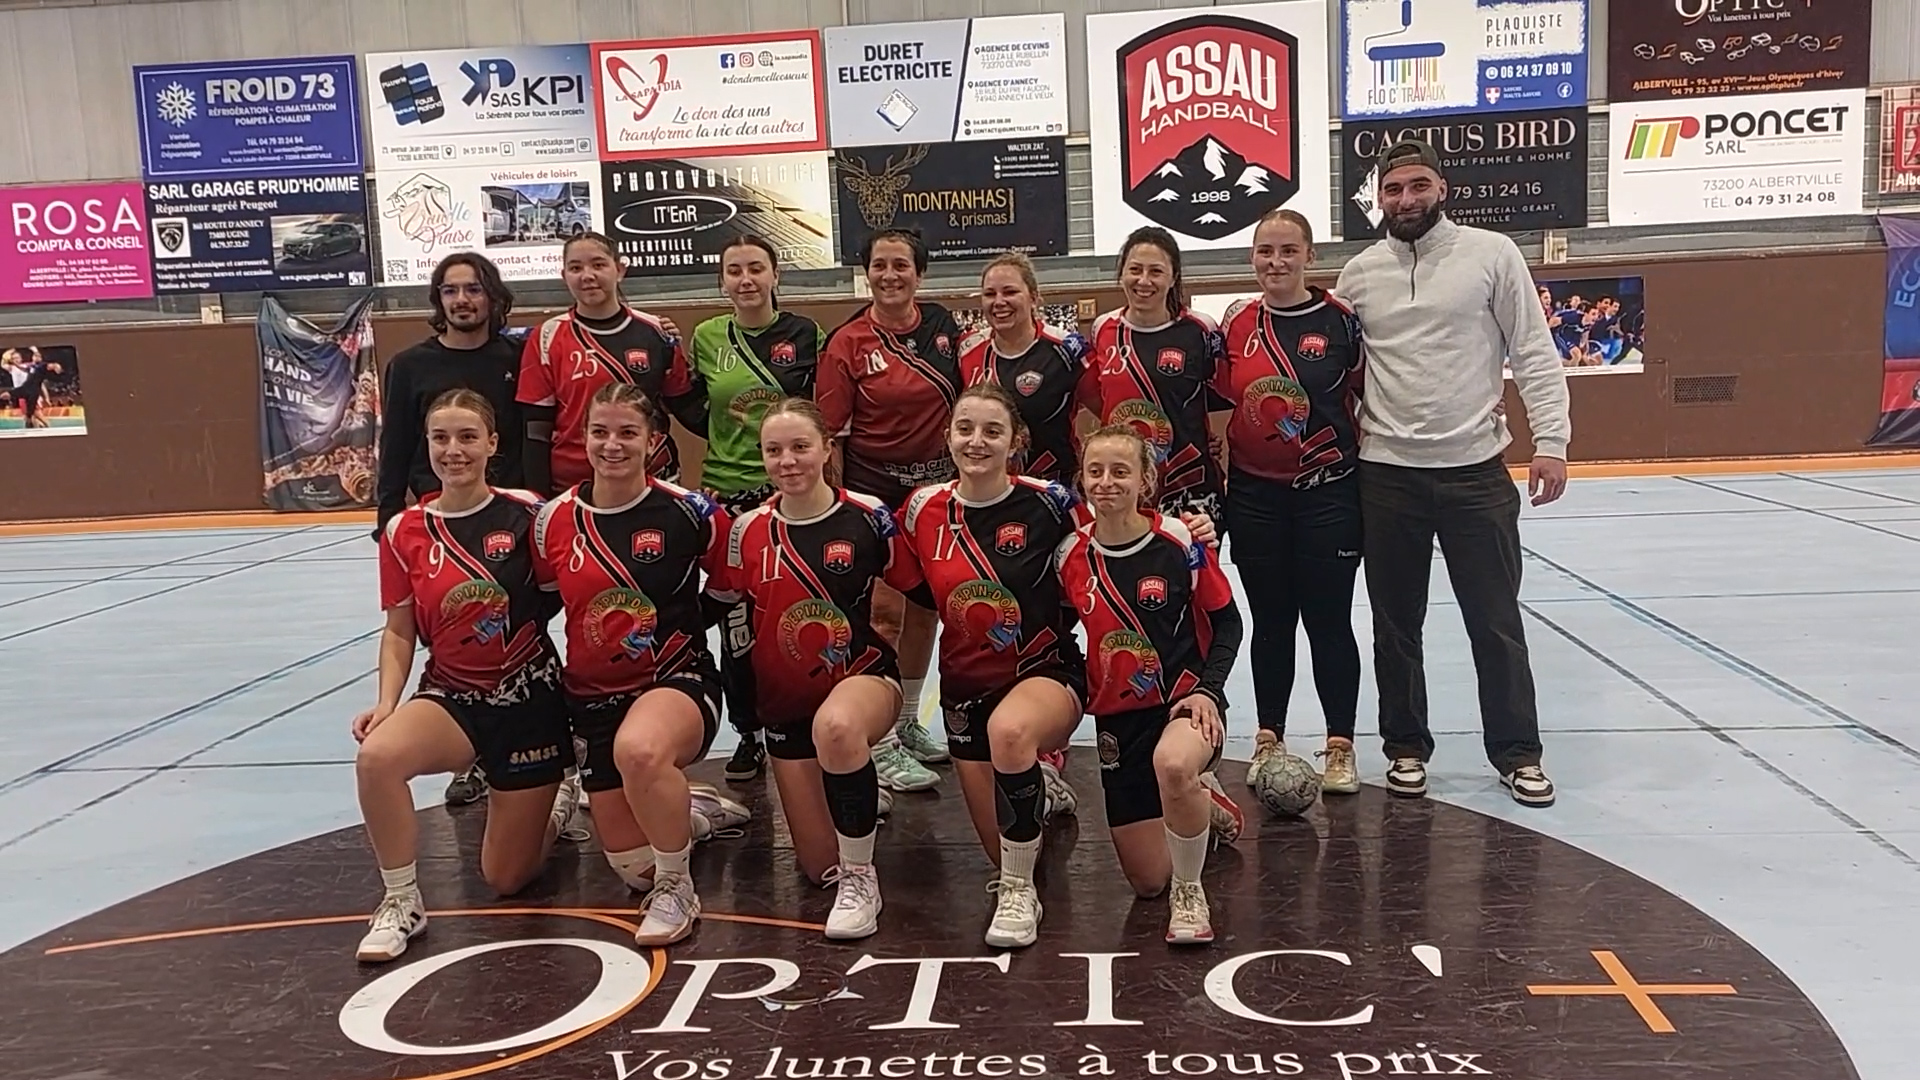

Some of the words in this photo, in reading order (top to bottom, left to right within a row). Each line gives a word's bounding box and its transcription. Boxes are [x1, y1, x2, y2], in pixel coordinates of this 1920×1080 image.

[1486, 13, 1563, 32] PLAQUISTE
[981, 44, 1010, 53] AGENCE
[1022, 42, 1050, 50] CEVINS
[1486, 31, 1544, 48] PEINTRE
[864, 42, 924, 63] DURET
[838, 60, 953, 84] ELECTRICITE
[1005, 60, 1031, 69] CEVINS
[1500, 66, 1513, 78] 06
[1516, 65, 1529, 77] 24
[1531, 64, 1544, 76] 37
[1546, 63, 1558, 75] 09
[1561, 62, 1573, 74] 10
[205, 76, 297, 105] FROID
[300, 72, 336, 100] 73
[974, 79, 1001, 87] AGENCE
[1003, 78, 1038, 86] D'ANNECY
[1141, 40, 1278, 122] ASSAU
[1632, 79, 1689, 91] ALBERTVILLE
[1747, 74, 1766, 83] Jeux
[1769, 71, 1815, 83] Olympiques
[490, 91, 522, 108] SAS
[522, 74, 585, 106] KPI
[997, 94, 1024, 102] ANNECY
[1034, 92, 1054, 100] VIEUX
[1368, 90, 1386, 105] FLO
[1401, 84, 1446, 103] TRAVAUX
[1684, 87, 1694, 95] 79
[208, 105, 270, 117] RÉFRIGÉRATION
[275, 103, 337, 114] CLIMATISATION
[234, 114, 267, 126] POMPES
[267, 113, 275, 124] À
[275, 114, 312, 125] CHALEUR
[514, 111, 531, 119] pour
[532, 109, 547, 118] tous
[548, 109, 560, 117] vos
[561, 107, 585, 117] projets
[672, 106, 689, 124] Le
[691, 107, 719, 120] don
[721, 105, 746, 119] des
[747, 105, 771, 118] uns
[1141, 102, 1278, 144] HANDBALL
[1705, 106, 1849, 139] PONCET
[619, 126, 693, 146] transforme
[695, 123, 710, 138] la
[712, 123, 732, 137] vie
[736, 120, 758, 135] des
[761, 119, 805, 134] autres
[1495, 117, 1577, 150] BIRD
[1007, 143, 1032, 152] WALTER
[1705, 139, 1746, 155] SARL
[1472, 156, 1511, 166] FEMME
[1517, 155, 1524, 163] &
[1530, 151, 1572, 162] HOMME
[490, 171, 535, 182] Véhicules
[537, 170, 549, 179] de
[550, 169, 579, 179] loisirs
[1703, 178, 1745, 191] 73200
[1748, 172, 1843, 190] ALBERTVILLE
[149, 184, 189, 200] SARL
[192, 181, 256, 198] GARAGE
[258, 176, 360, 196] PRUD'HOMME
[1190, 190, 1231, 203] 1998
[1453, 186, 1473, 199] 79
[1477, 185, 1494, 198] 31
[1499, 183, 1520, 197] 24
[1525, 181, 1542, 195] 16
[155, 203, 209, 215] Réparateur
[211, 202, 238, 213] agréé
[240, 200, 279, 211] Peugeot
[1703, 196, 1731, 209] TÉL.
[1735, 195, 1752, 207] 04
[1757, 194, 1774, 206] 79
[1778, 192, 1792, 205] 31
[1796, 192, 1813, 204] 24
[1817, 191, 1836, 203] 08
[12, 197, 142, 236] ROSA
[653, 203, 698, 226] IT'EnR
[1451, 204, 1518, 217] COMMERCIAL
[204, 221, 226, 229] ROUTE
[229, 219, 265, 229] D'ANNECY
[949, 213, 960, 228] &
[961, 211, 1008, 231] prismas
[17, 239, 74, 253] COMPTA
[75, 238, 86, 251] &
[86, 235, 144, 251] CONSEIL
[617, 239, 694, 253] ALBERTVILLE
[492, 254, 531, 266] contact
[1243, 327, 1264, 358] 6
[570, 349, 599, 381] 25
[715, 344, 739, 373] 16
[1102, 345, 1131, 375] 23
[264, 356, 312, 382] HAND
[636, 533, 661, 545] ASSAU
[931, 523, 964, 561] 17
[428, 541, 445, 579] 9
[569, 533, 587, 573] 8
[759, 543, 784, 585] 11
[1082, 575, 1098, 615] 3
[1141, 580, 1164, 592] ASSAU
[951, 584, 1018, 636] PEPIN-DONAT
[782, 602, 848, 656] PEPIN-DONAT
[509, 745, 559, 764] SAMSE
[606, 1050, 734, 1080] Vos
[753, 1047, 1048, 1080] lunettes
[1077, 1043, 1115, 1077] à
[1142, 1047, 1305, 1077] tous
[1330, 1043, 1494, 1080] prix
